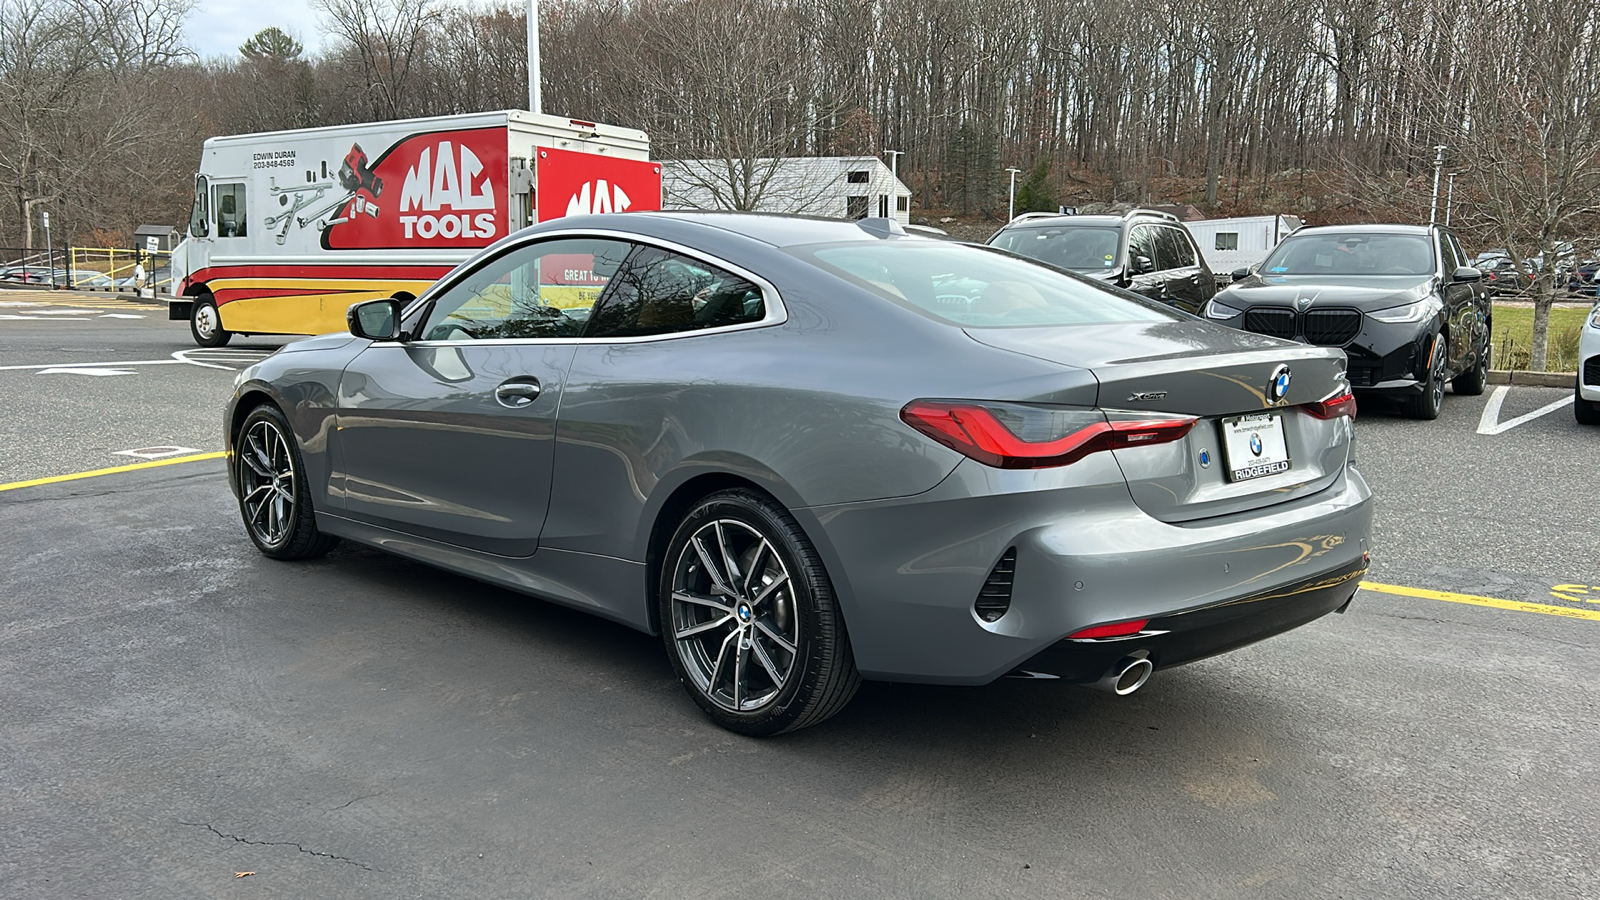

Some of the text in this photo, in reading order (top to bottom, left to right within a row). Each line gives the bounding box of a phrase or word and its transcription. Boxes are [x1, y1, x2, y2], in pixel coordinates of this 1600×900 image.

[253, 150, 296, 160] EDWIN DURAN
[400, 141, 495, 211] MAC
[400, 213, 496, 239] TOOLS
[564, 269, 588, 281] GREAT
[1235, 461, 1289, 480] RIDGEFIELD
